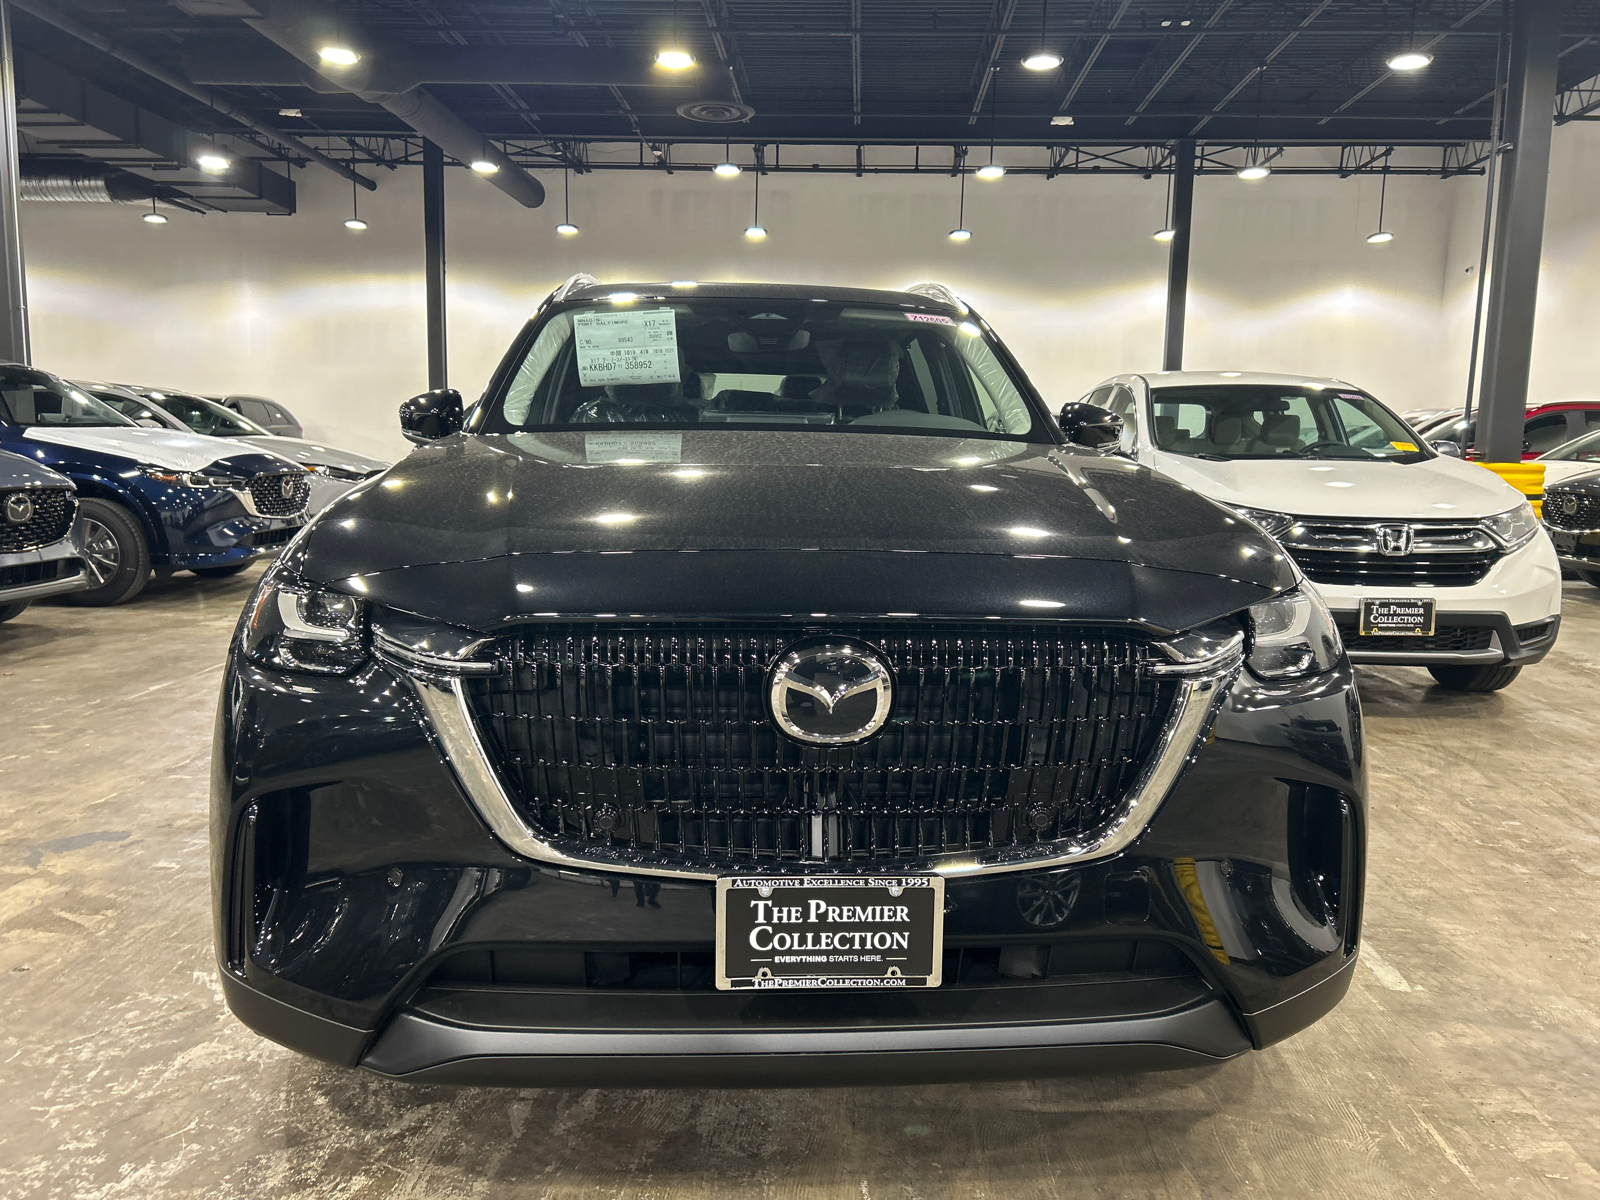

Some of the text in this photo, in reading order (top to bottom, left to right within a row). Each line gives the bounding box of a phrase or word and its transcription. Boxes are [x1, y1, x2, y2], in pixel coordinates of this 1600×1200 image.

[589, 362, 617, 372] KKBHD7
[625, 360, 653, 370] 358952
[1371, 605, 1424, 615] THE PREMIER
[1370, 613, 1424, 623] COLLECTION
[734, 877, 929, 887] AUTOMOTIVE EXCELLENCE SINCE 1995
[750, 899, 911, 924] THE PREMIER
[749, 925, 910, 951] COLLECTION
[774, 955, 827, 963] EVERYTHING
[860, 954, 884, 962] HERE.
[751, 977, 906, 988] THEPREMIERCOLLECTION.COM
